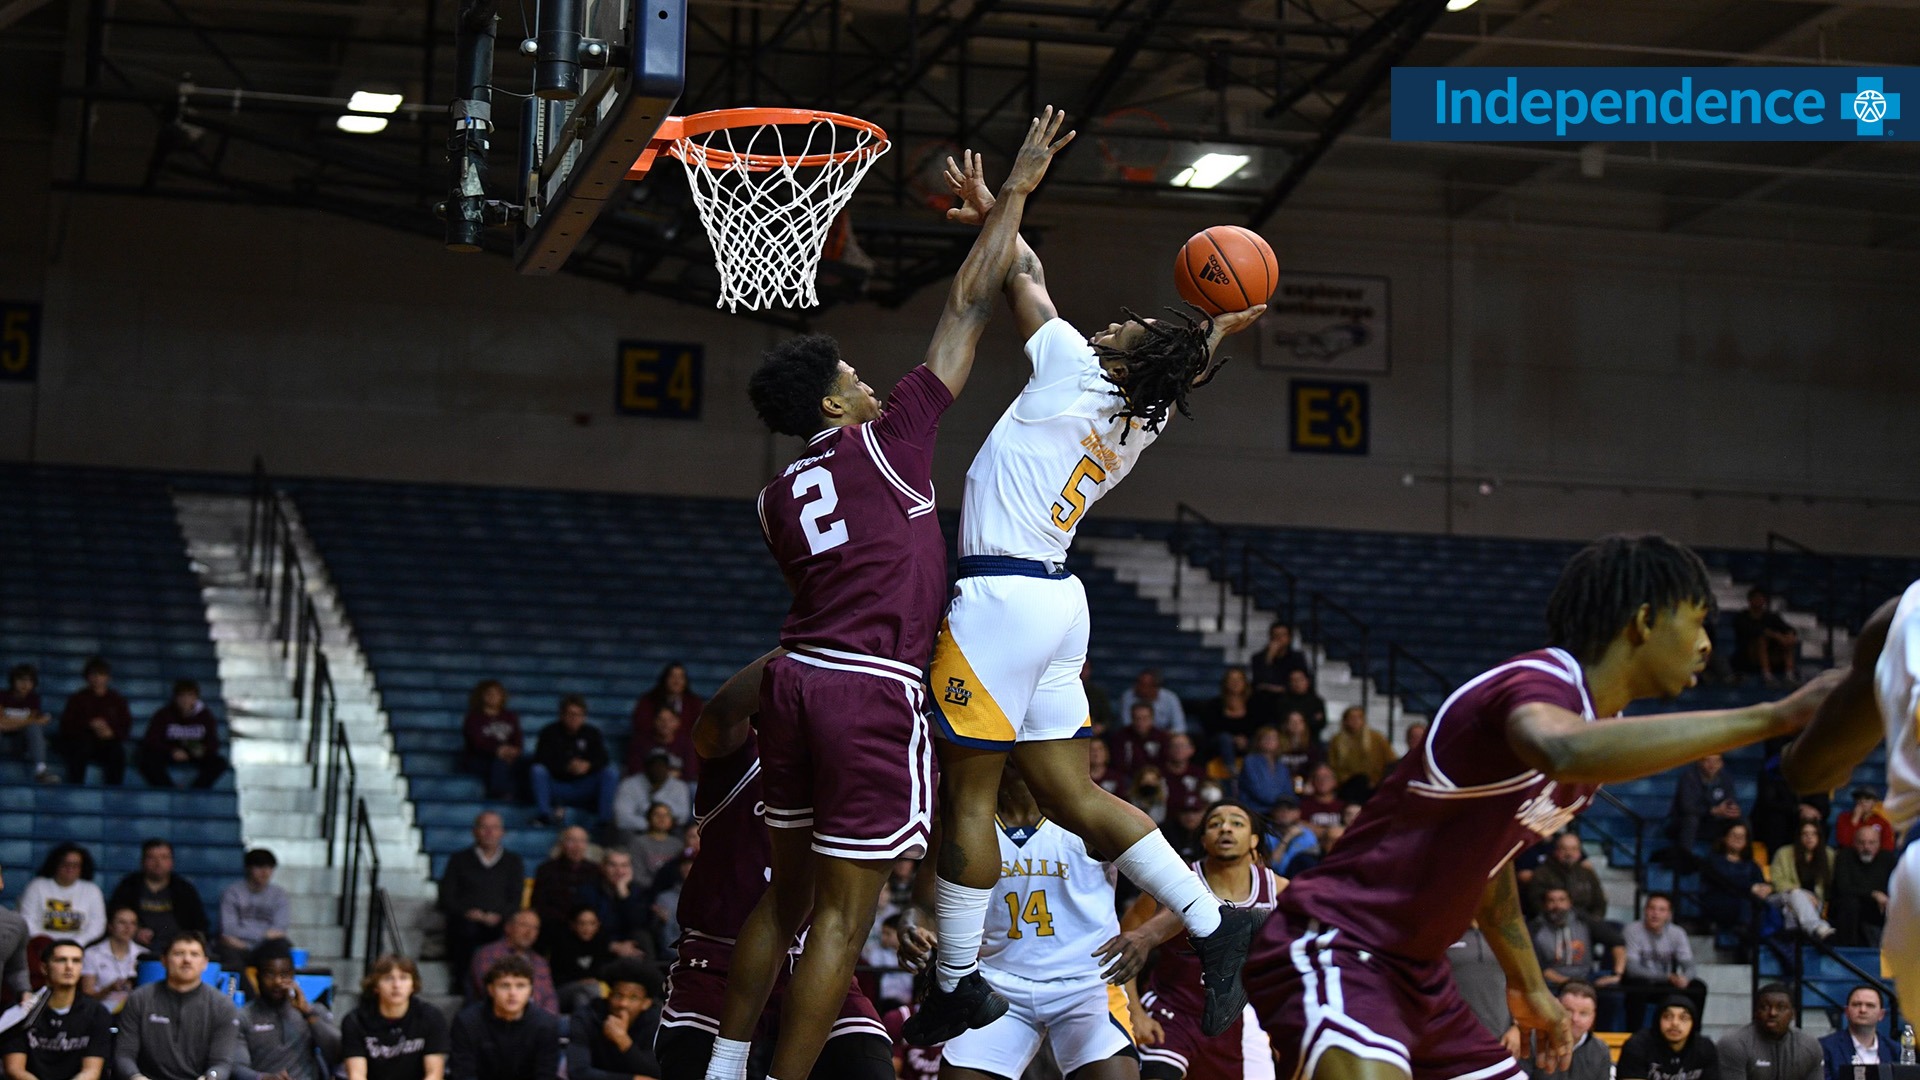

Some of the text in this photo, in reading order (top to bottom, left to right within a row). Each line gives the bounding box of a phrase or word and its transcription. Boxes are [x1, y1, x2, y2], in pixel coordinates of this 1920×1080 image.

[1208, 254, 1230, 285] adidas
[622, 349, 694, 411] E4
[1296, 386, 1362, 448] E3
[792, 465, 850, 556] 2
[1051, 454, 1107, 533] 5
[1001, 858, 1070, 881] SALLE
[1004, 889, 1055, 939] 14
